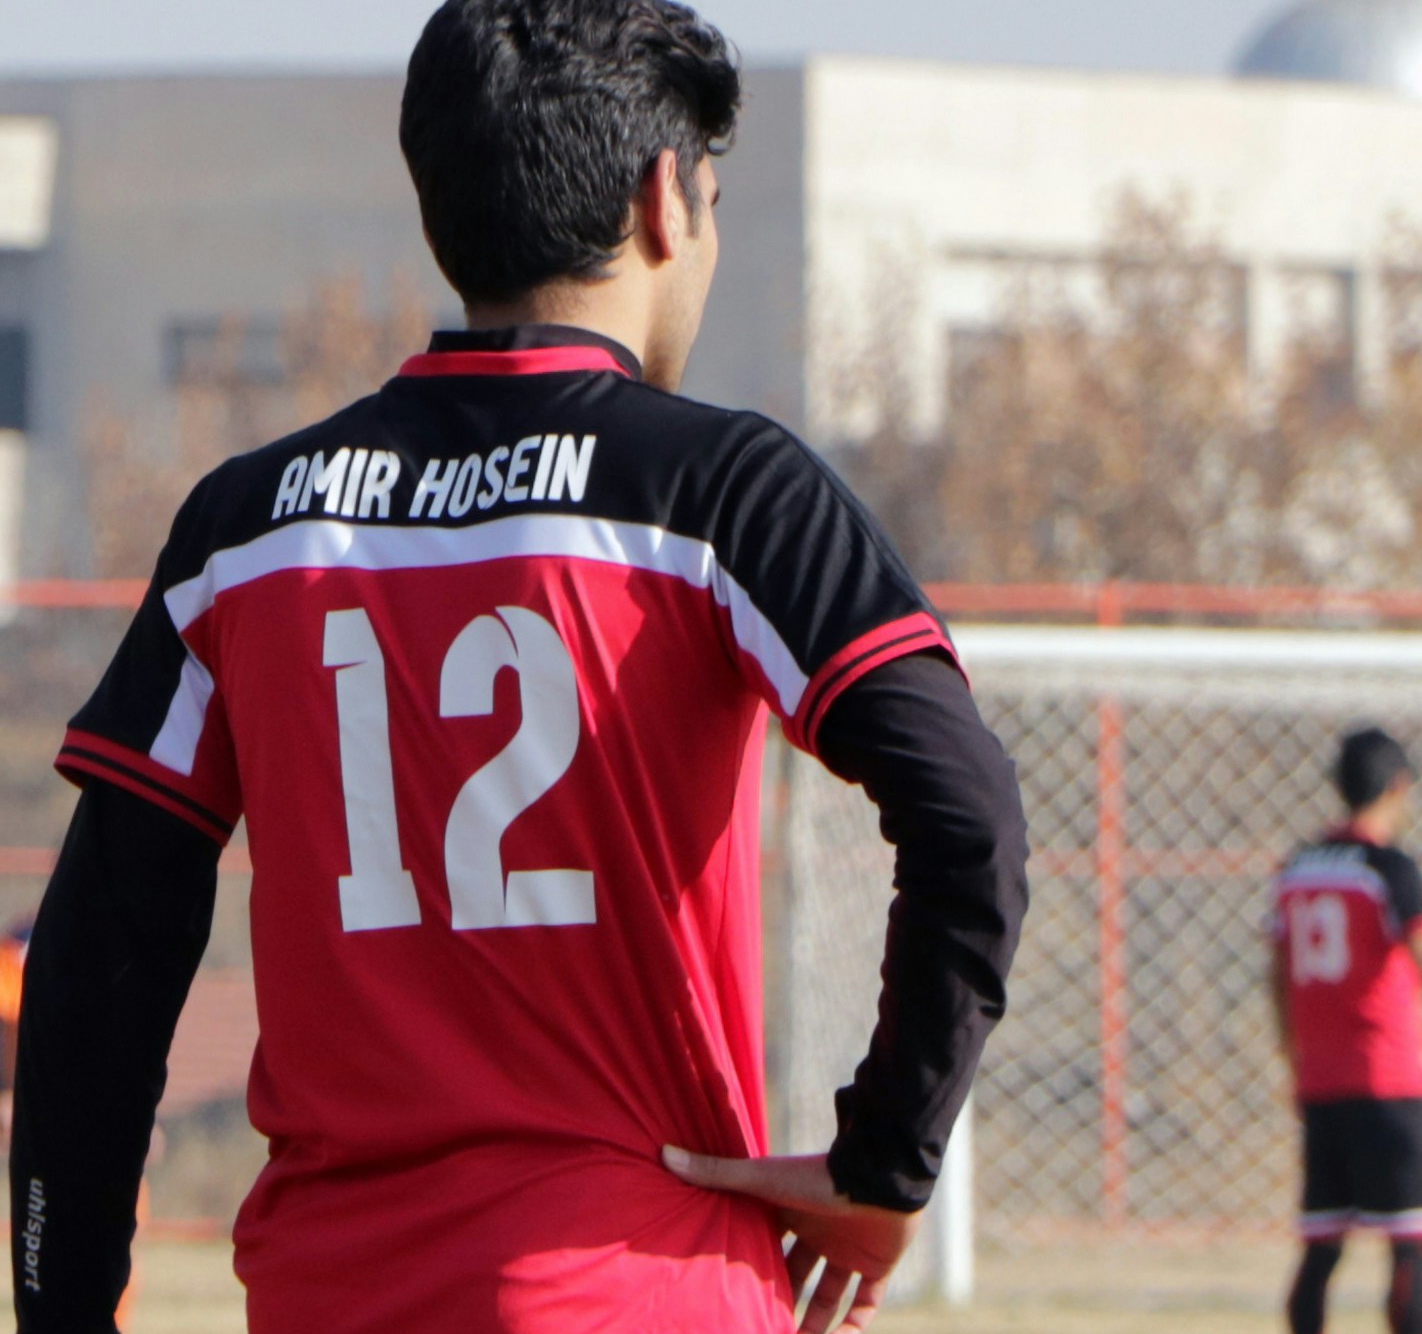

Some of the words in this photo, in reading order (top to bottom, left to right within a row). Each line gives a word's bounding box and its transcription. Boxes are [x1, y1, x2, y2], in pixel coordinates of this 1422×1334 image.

[271, 447, 401, 520] AMIR
[408, 434, 597, 518] HOSEIN
[322, 605, 597, 932] 12
[22, 1177, 47, 1292] uhlsport
